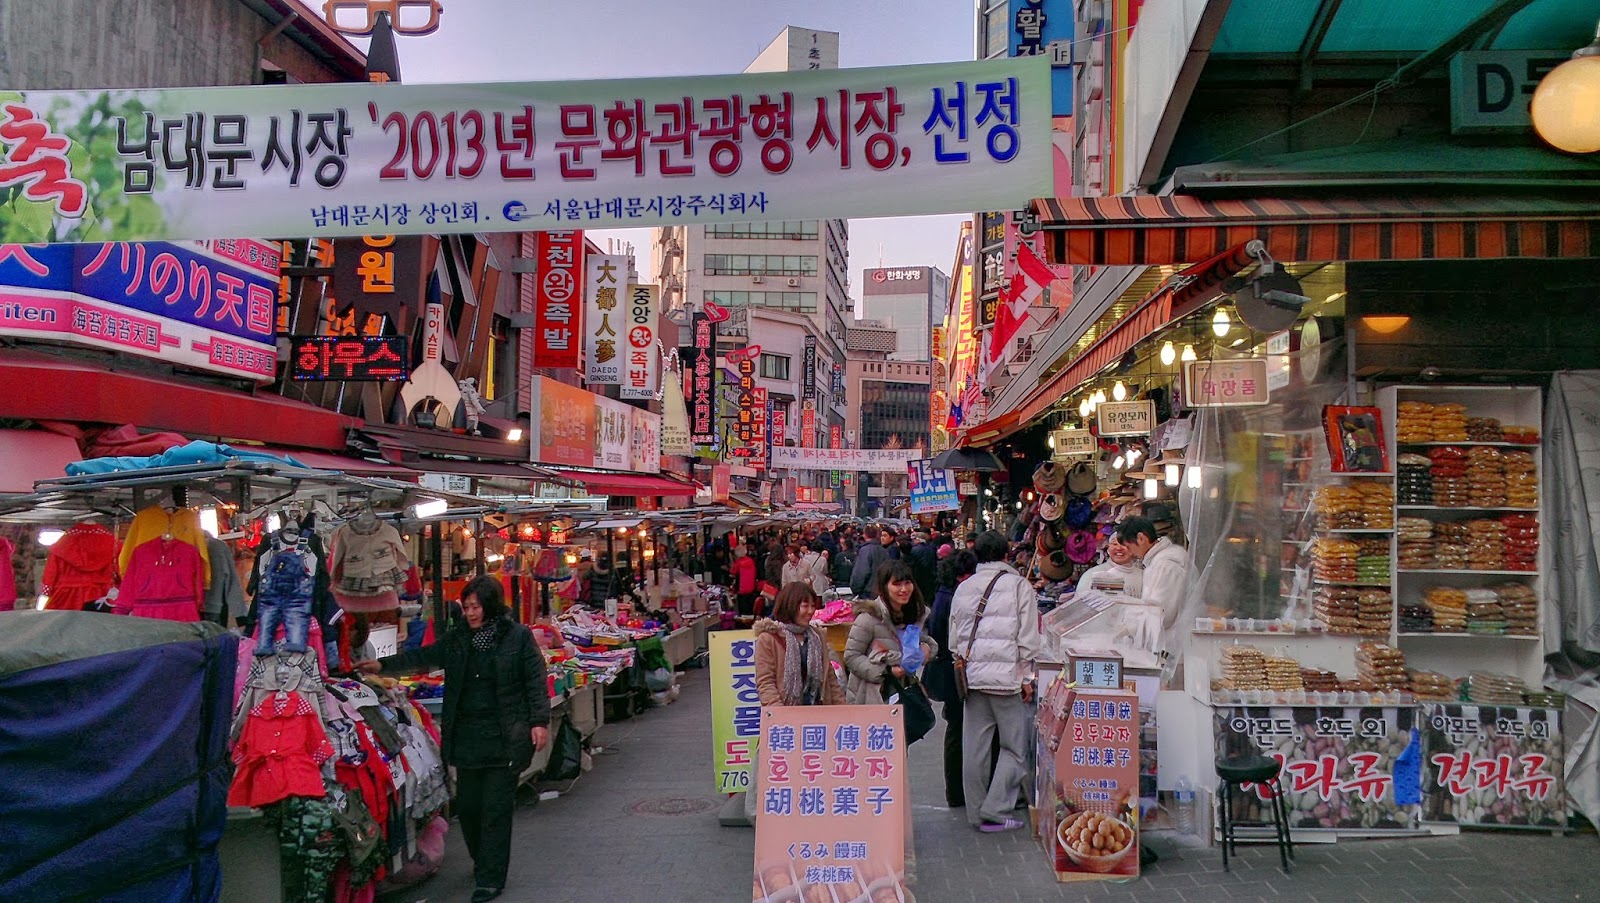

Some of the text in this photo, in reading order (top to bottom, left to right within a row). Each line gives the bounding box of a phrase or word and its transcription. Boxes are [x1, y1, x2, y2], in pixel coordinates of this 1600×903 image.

[1053, 43, 1068, 62] 1F
[115, 107, 352, 194] 남대문시장
[368, 101, 536, 180] '2013년
[555, 90, 795, 180] 문화관광형
[807, 86, 912, 172] 시장,
[924, 77, 1020, 165] 선정
[310, 205, 412, 228] 남대문시장
[543, 192, 769, 221] 서울남대문시장주식회사
[886, 269, 921, 281] 한화생명
[0, 303, 56, 322] iten
[595, 259, 618, 364] 大都人蔘
[72, 306, 158, 347] 海苔海苔天国
[428, 306, 441, 360] 카이스트
[299, 342, 401, 377] 하우스
[591, 366, 618, 374] DAEDO
[805, 347, 814, 387] COFFEE
[741, 361, 751, 423] 크리스탈
[1201, 379, 1257, 397] 화장품
[1107, 411, 1148, 424] 유성모자
[1072, 700, 1132, 720] 韓國傳統
[768, 724, 894, 751] 韓國傳統
[1072, 723, 1131, 743] 호두과자
[1315, 716, 1354, 739] 호두
[1361, 717, 1387, 738] 외
[1496, 717, 1525, 740] 호두
[1531, 720, 1551, 740] 외
[768, 753, 893, 782] 호두과자
[1071, 748, 1132, 767] 胡桃菓子
[1073, 779, 1096, 789] くるみ
[1432, 750, 1555, 799] 견과류
[765, 787, 893, 816] 胡桃菓子
[787, 843, 829, 859] くるみ
